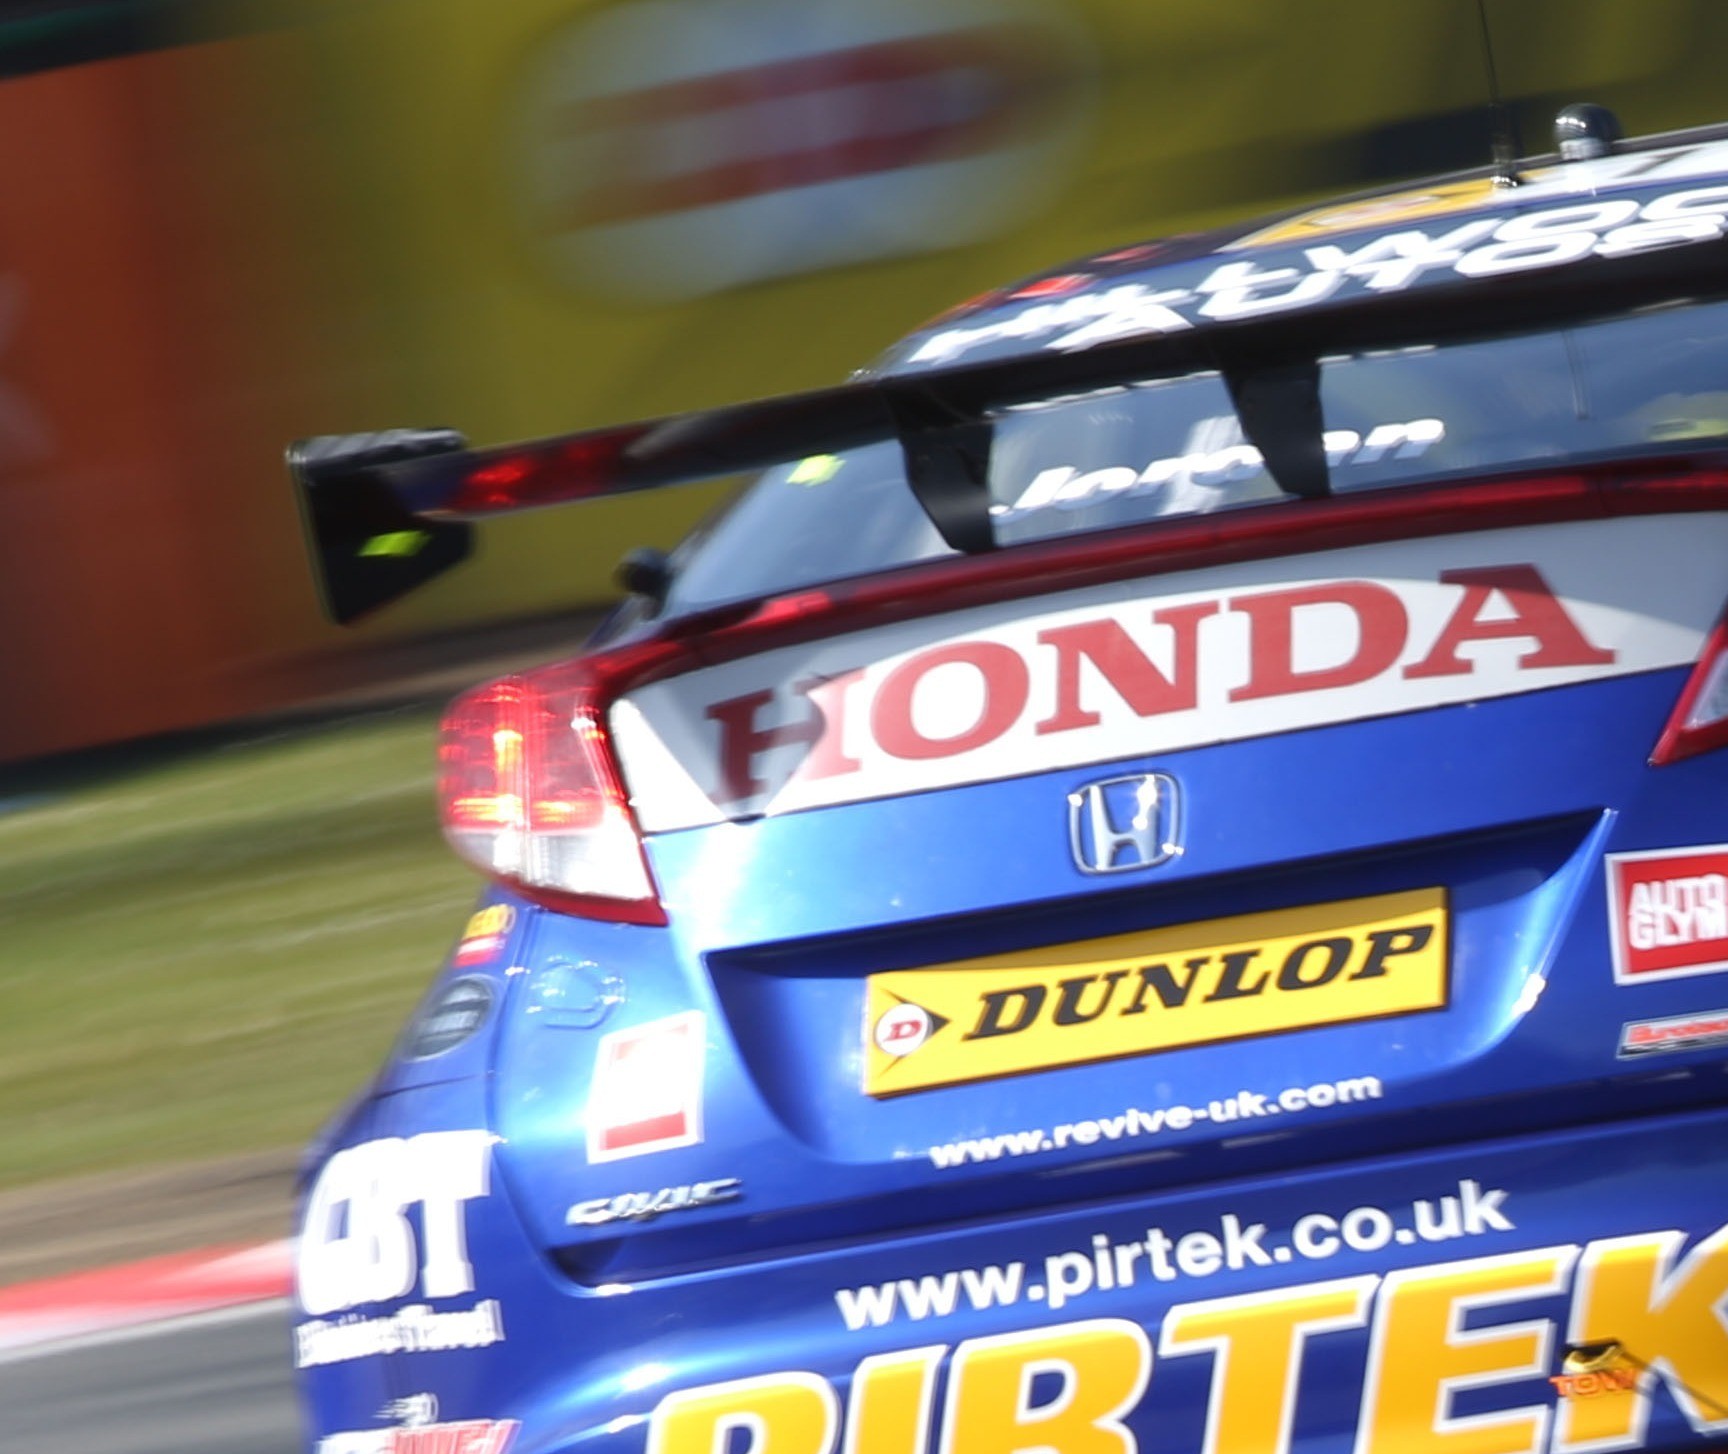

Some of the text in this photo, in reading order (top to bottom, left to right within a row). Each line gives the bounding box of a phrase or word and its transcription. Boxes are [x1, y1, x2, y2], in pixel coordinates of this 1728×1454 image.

[706, 564, 1615, 798] HONDA
[961, 924, 1434, 1042] DUNLOP
[930, 1074, 1382, 1168] www.revive-uk.com
[836, 1179, 1516, 1332] www.pirtek.co.uk
